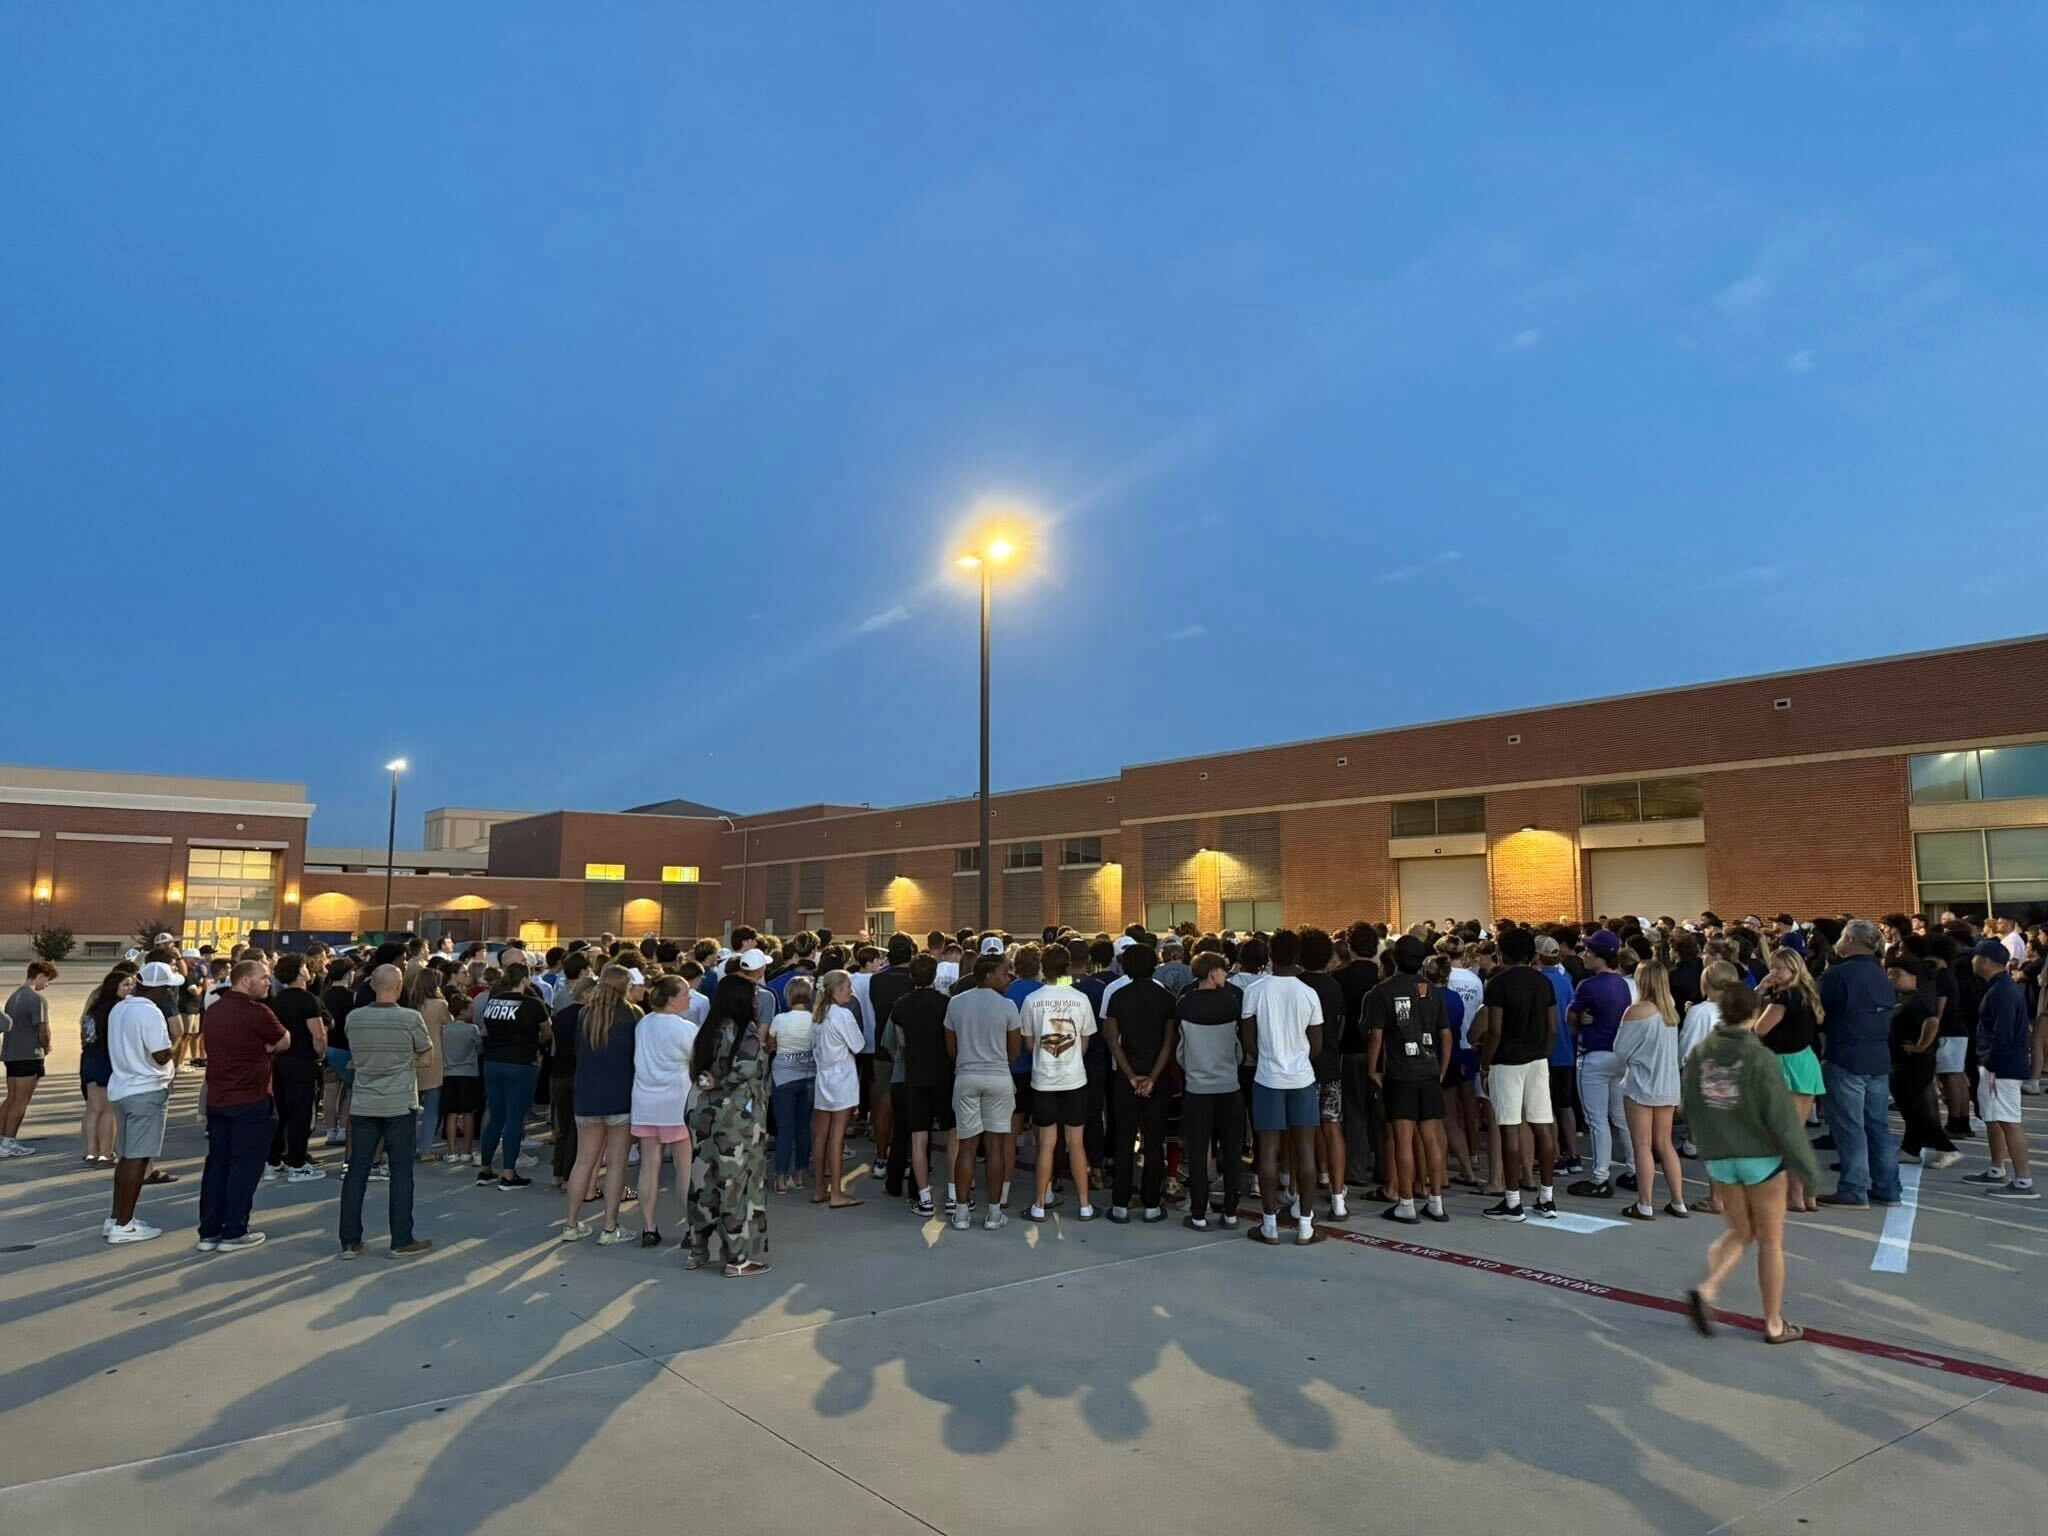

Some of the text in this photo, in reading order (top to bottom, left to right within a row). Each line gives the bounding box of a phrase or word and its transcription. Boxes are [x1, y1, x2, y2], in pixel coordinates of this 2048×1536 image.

[483, 1006, 518, 1020] WORK
[1345, 1234, 1388, 1245] FIRE
[1392, 1244, 1447, 1258] LANE
[1468, 1258, 1501, 1269] NO
[1511, 1268, 1612, 1295] PARKING
